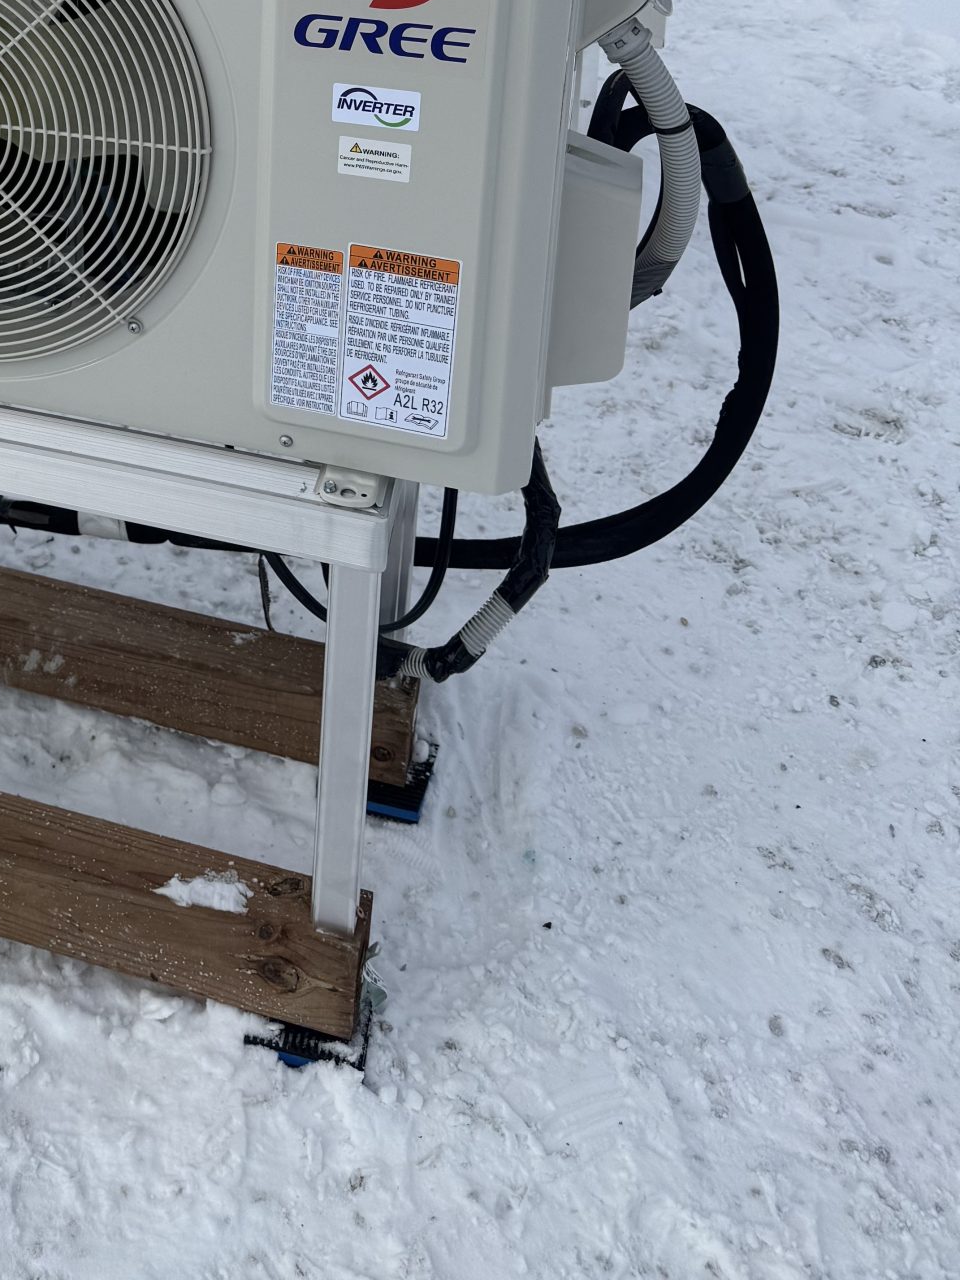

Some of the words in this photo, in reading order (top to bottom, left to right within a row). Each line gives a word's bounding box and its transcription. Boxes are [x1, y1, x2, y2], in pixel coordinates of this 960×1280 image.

[294, 14, 476, 63] GREE
[337, 98, 415, 117] INVERTER
[362, 149, 400, 159] WARNING:
[298, 247, 334, 260] WARNING
[386, 251, 437, 268] WARNING
[291, 258, 340, 273] AVERTISSEMENT
[370, 261, 451, 281] AVERTISSEMENT
[352, 268, 364, 279] RISK
[365, 270, 372, 279] OF
[388, 274, 418, 288] FLAMMABLE
[420, 279, 456, 294] REFRIGERANT
[350, 290, 371, 301] SERVICE
[405, 300, 414, 309] DO
[415, 302, 426, 311] NOT
[427, 304, 454, 317] PUNCTURE
[368, 282, 374, 291] TO
[376, 283, 383, 292] BE
[384, 284, 408, 298] REPAIRED
[410, 288, 424, 299] ONLY
[425, 292, 432, 301] BY
[434, 294, 455, 306] TRAINED
[350, 301, 387, 313] REFRIGERANT
[389, 307, 410, 320] TUBING.
[349, 315, 364, 326] RISQUE
[378, 331, 386, 341] PAR
[388, 333, 397, 343] UNE
[399, 336, 424, 348] PERSONNE
[426, 341, 450, 353] QUALIFIÉE
[347, 348, 353, 357] DE
[375, 342, 382, 351] NE
[383, 343, 392, 353] PAS
[393, 345, 417, 358] PERFORER
[418, 349, 424, 359] LA
[426, 351, 449, 364] TUBULURE
[396, 369, 419, 379] Refrigerant
[419, 372, 432, 381] Safety
[433, 376, 446, 384] Group
[394, 393, 418, 410] A2L
[422, 398, 444, 415] R32
